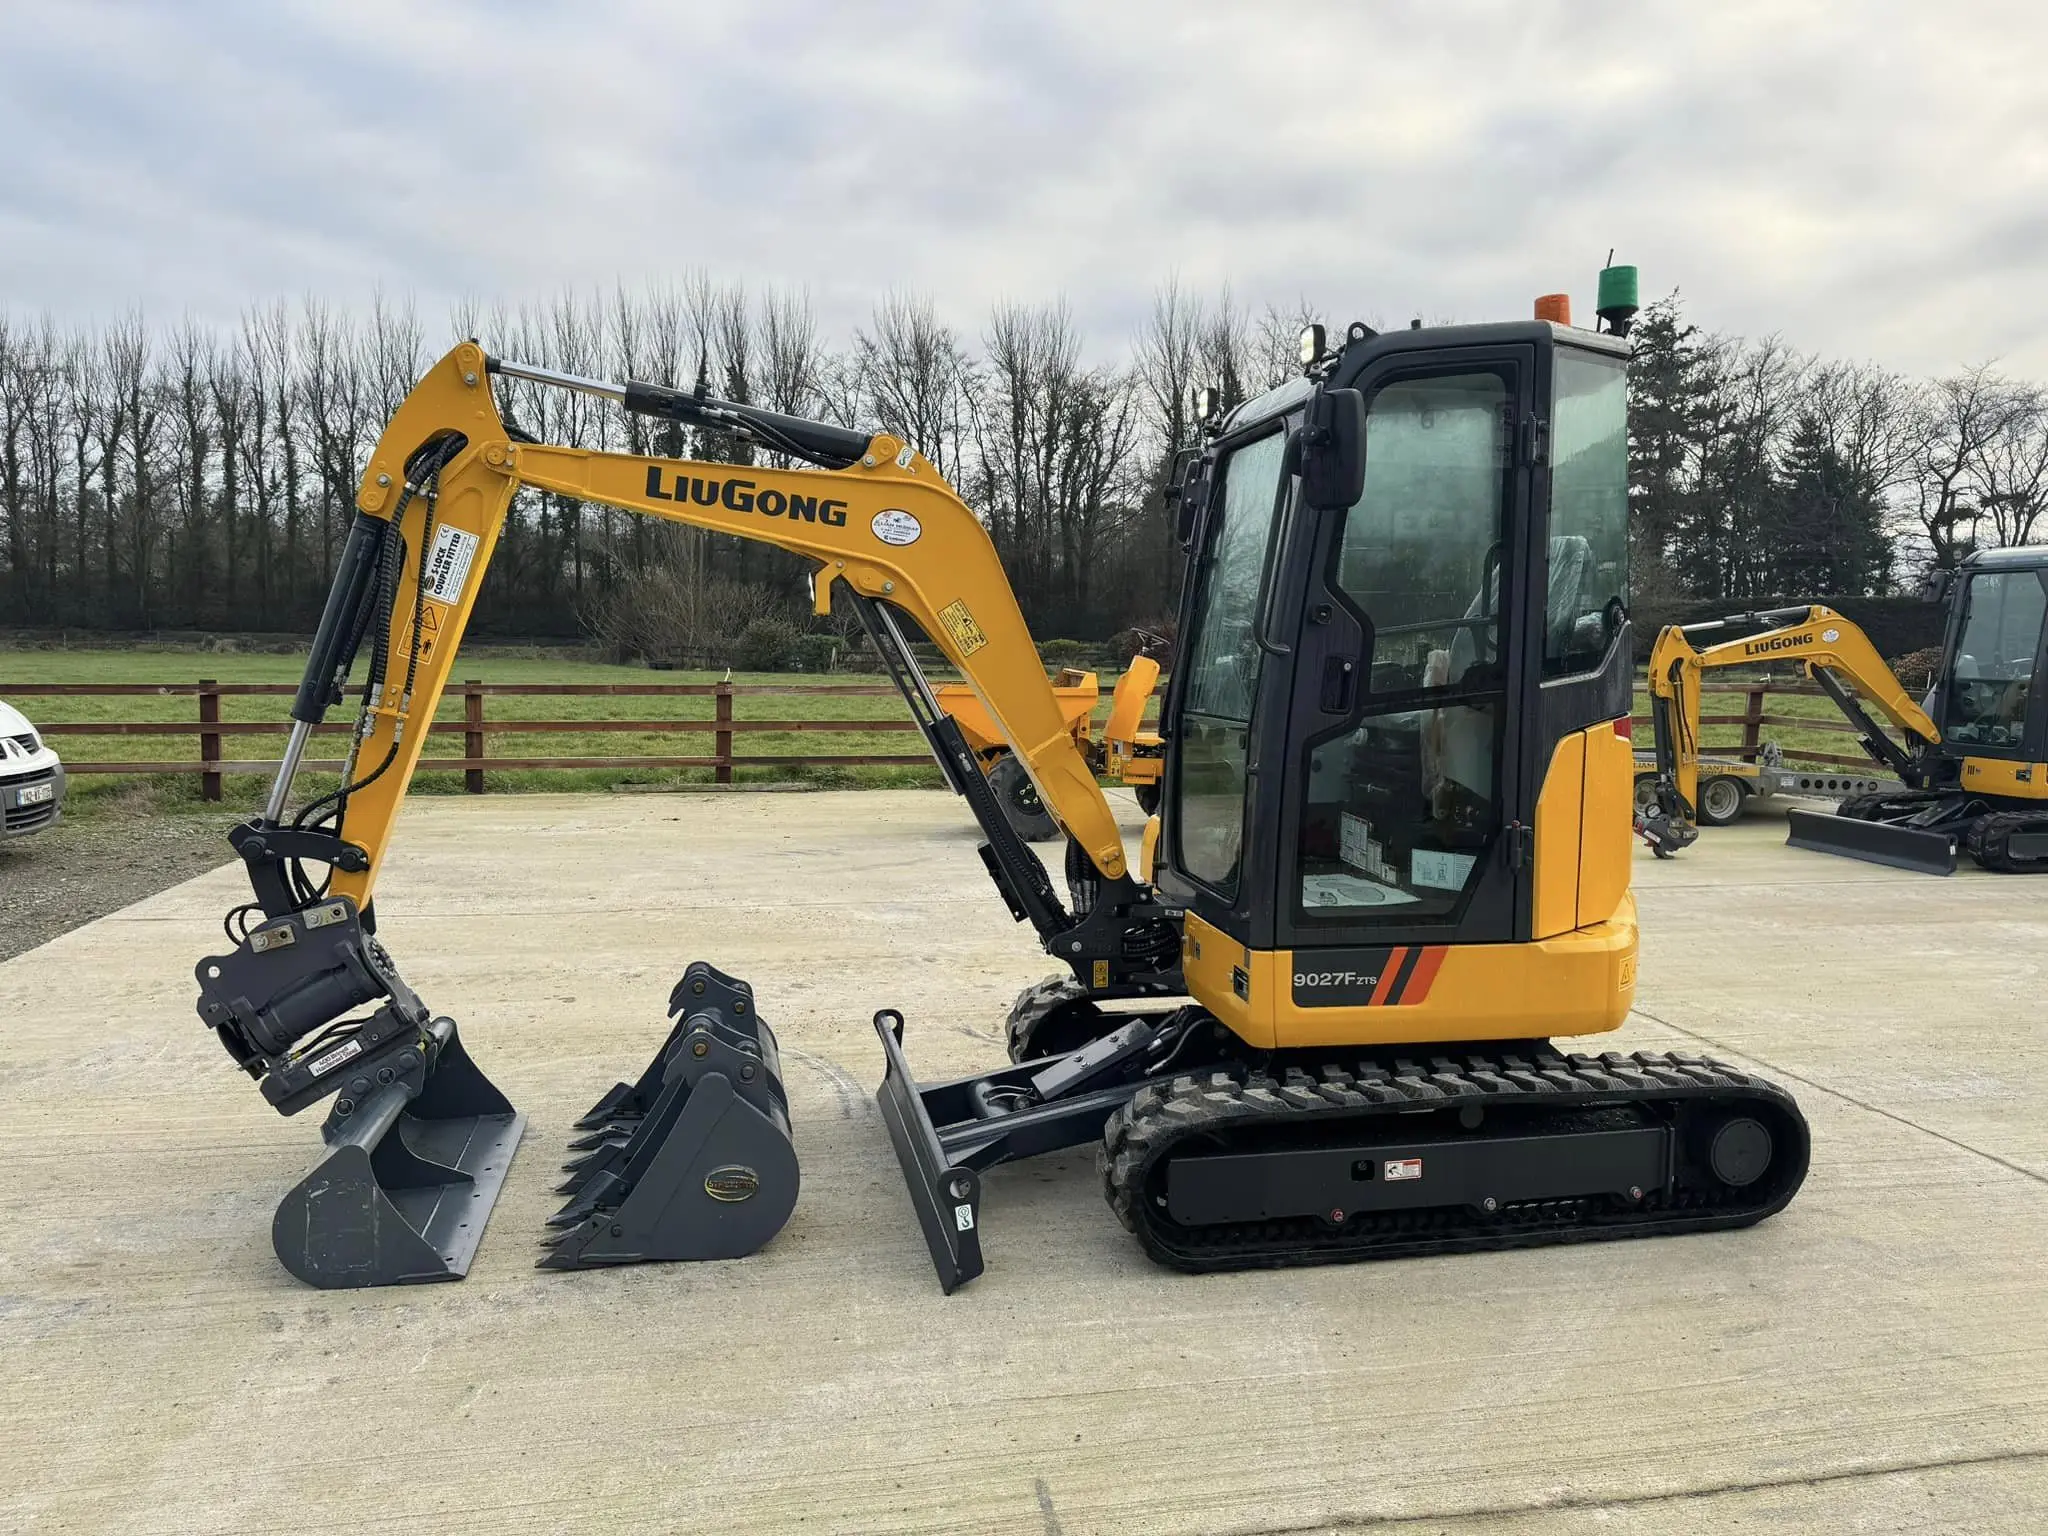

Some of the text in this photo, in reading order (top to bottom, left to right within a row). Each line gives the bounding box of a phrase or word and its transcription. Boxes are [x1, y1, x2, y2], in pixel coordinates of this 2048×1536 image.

[432, 547, 447, 575] S-LOCK
[434, 533, 460, 594] COUPLER FITTED
